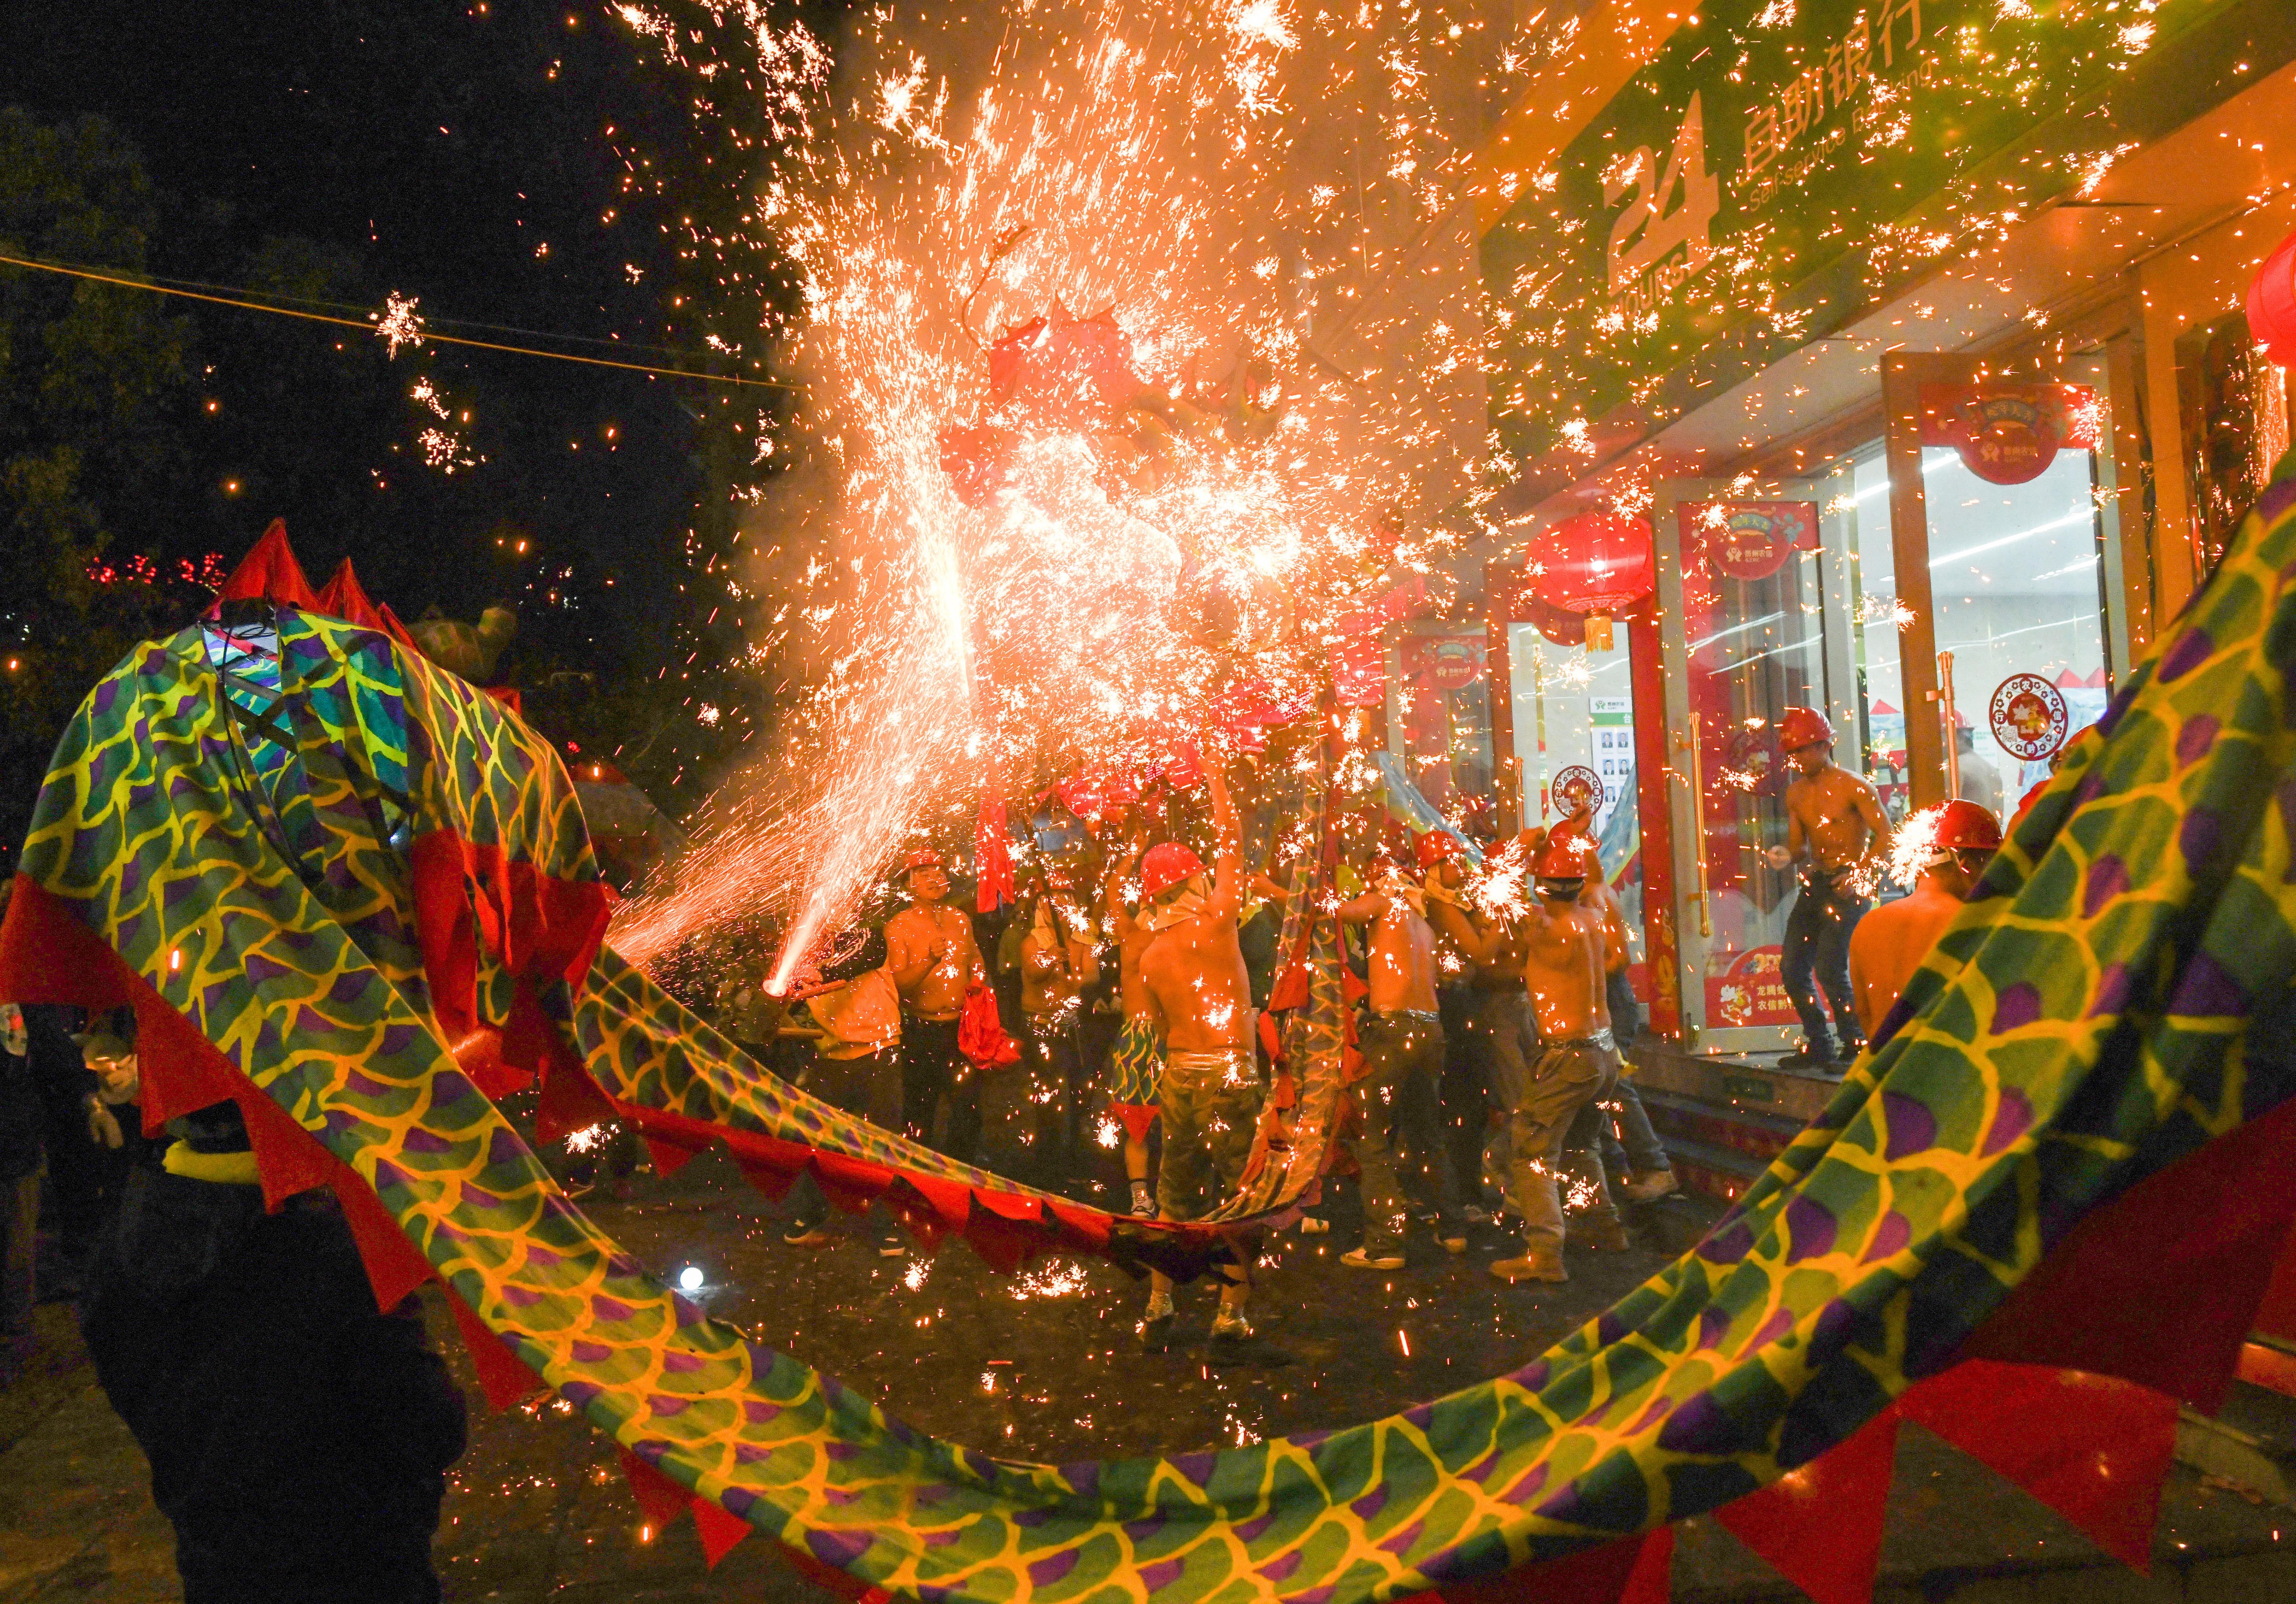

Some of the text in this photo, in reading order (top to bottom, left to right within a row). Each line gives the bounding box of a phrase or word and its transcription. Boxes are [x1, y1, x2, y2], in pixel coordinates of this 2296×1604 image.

[1745, 0, 1921, 177] 自助银行
[1604, 89, 1719, 297] 24
